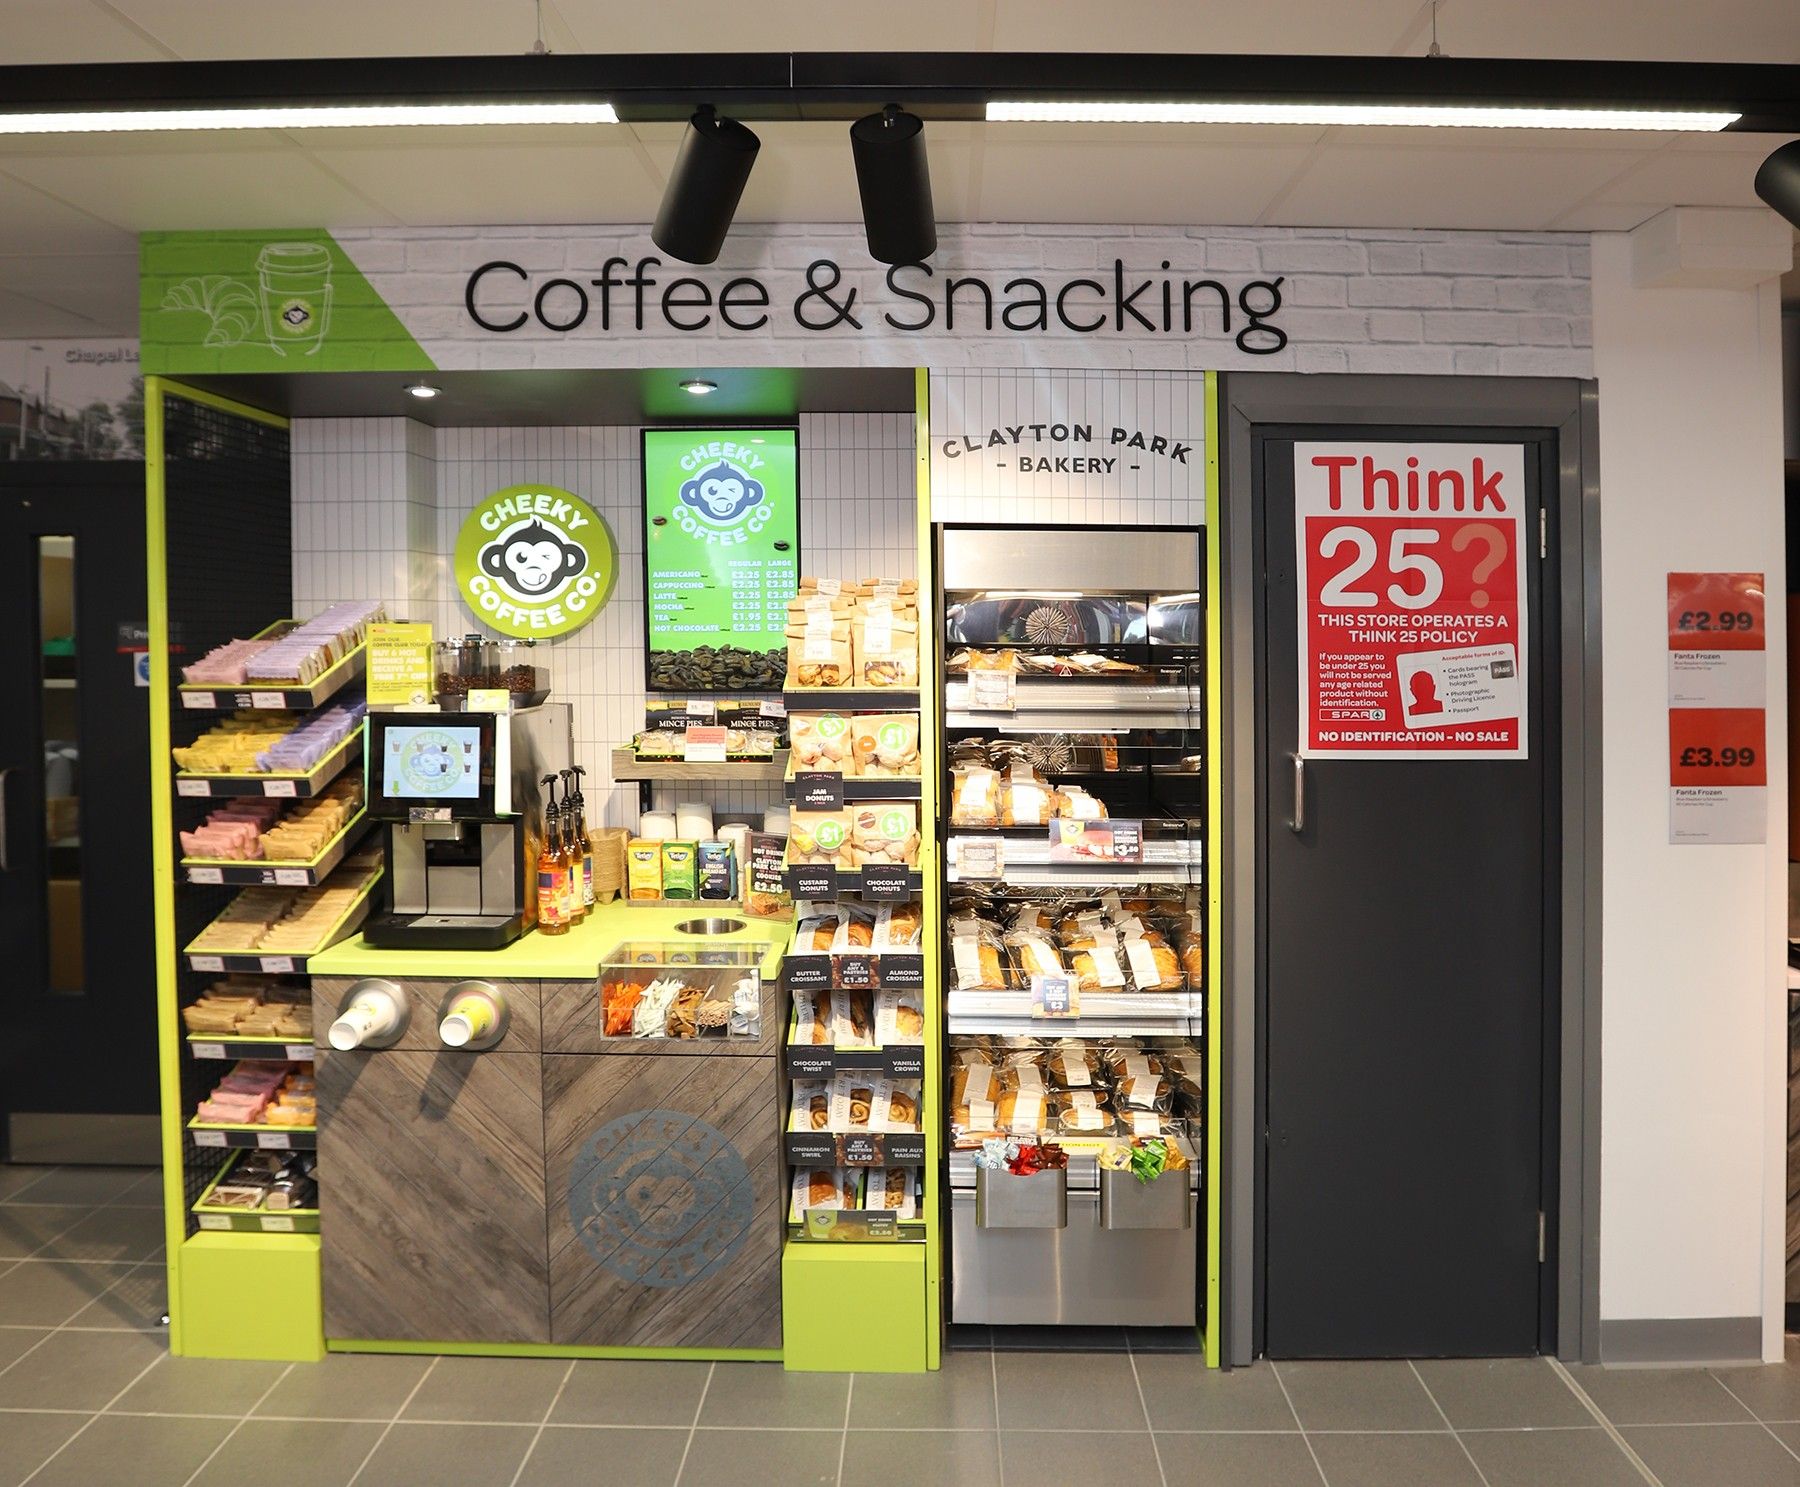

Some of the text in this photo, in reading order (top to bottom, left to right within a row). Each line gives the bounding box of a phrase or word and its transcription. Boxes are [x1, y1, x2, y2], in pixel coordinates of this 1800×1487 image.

[465, 257, 1288, 355] Coffee & Snacking
[942, 424, 1193, 466] CLAYTON PARK
[680, 441, 764, 471] CHEEKY
[1018, 457, 1117, 474] BAKERY
[1311, 455, 1507, 513] Think
[480, 494, 588, 531] CHEEKY
[672, 505, 748, 546] COFFEE
[732, 571, 760, 579] £2.25
[766, 571, 794, 579] £2.85
[732, 580, 760, 589] £2.25
[766, 580, 794, 588] £2.85
[469, 571, 601, 629] COFFEE CO.
[732, 591, 761, 599] £2.25
[767, 591, 795, 599] £2.85
[732, 602, 761, 610] £2.25
[732, 613, 761, 621] £1.95
[1318, 615, 1508, 628] THIS STORE OPERATES A
[1678, 611, 1754, 632] £2.99
[1349, 630, 1478, 644] THINK 25 POLICY
[1327, 654, 1343, 662] you
[1344, 654, 1374, 662] appear
[1369, 663, 1385, 671] you
[1320, 671, 1391, 679] will not be served
[1320, 681, 1335, 689] any
[1336, 681, 1352, 689] age
[1320, 690, 1354, 698] product
[1320, 699, 1379, 707] identification.
[1331, 711, 1370, 719] SPAR
[1319, 732, 1339, 741] NO
[1341, 732, 1444, 742] IDENTIFICATION
[1455, 732, 1475, 741] NO
[1476, 732, 1509, 741] SALE
[1680, 747, 1755, 767] £3.99
[754, 881, 783, 893] £2.50
